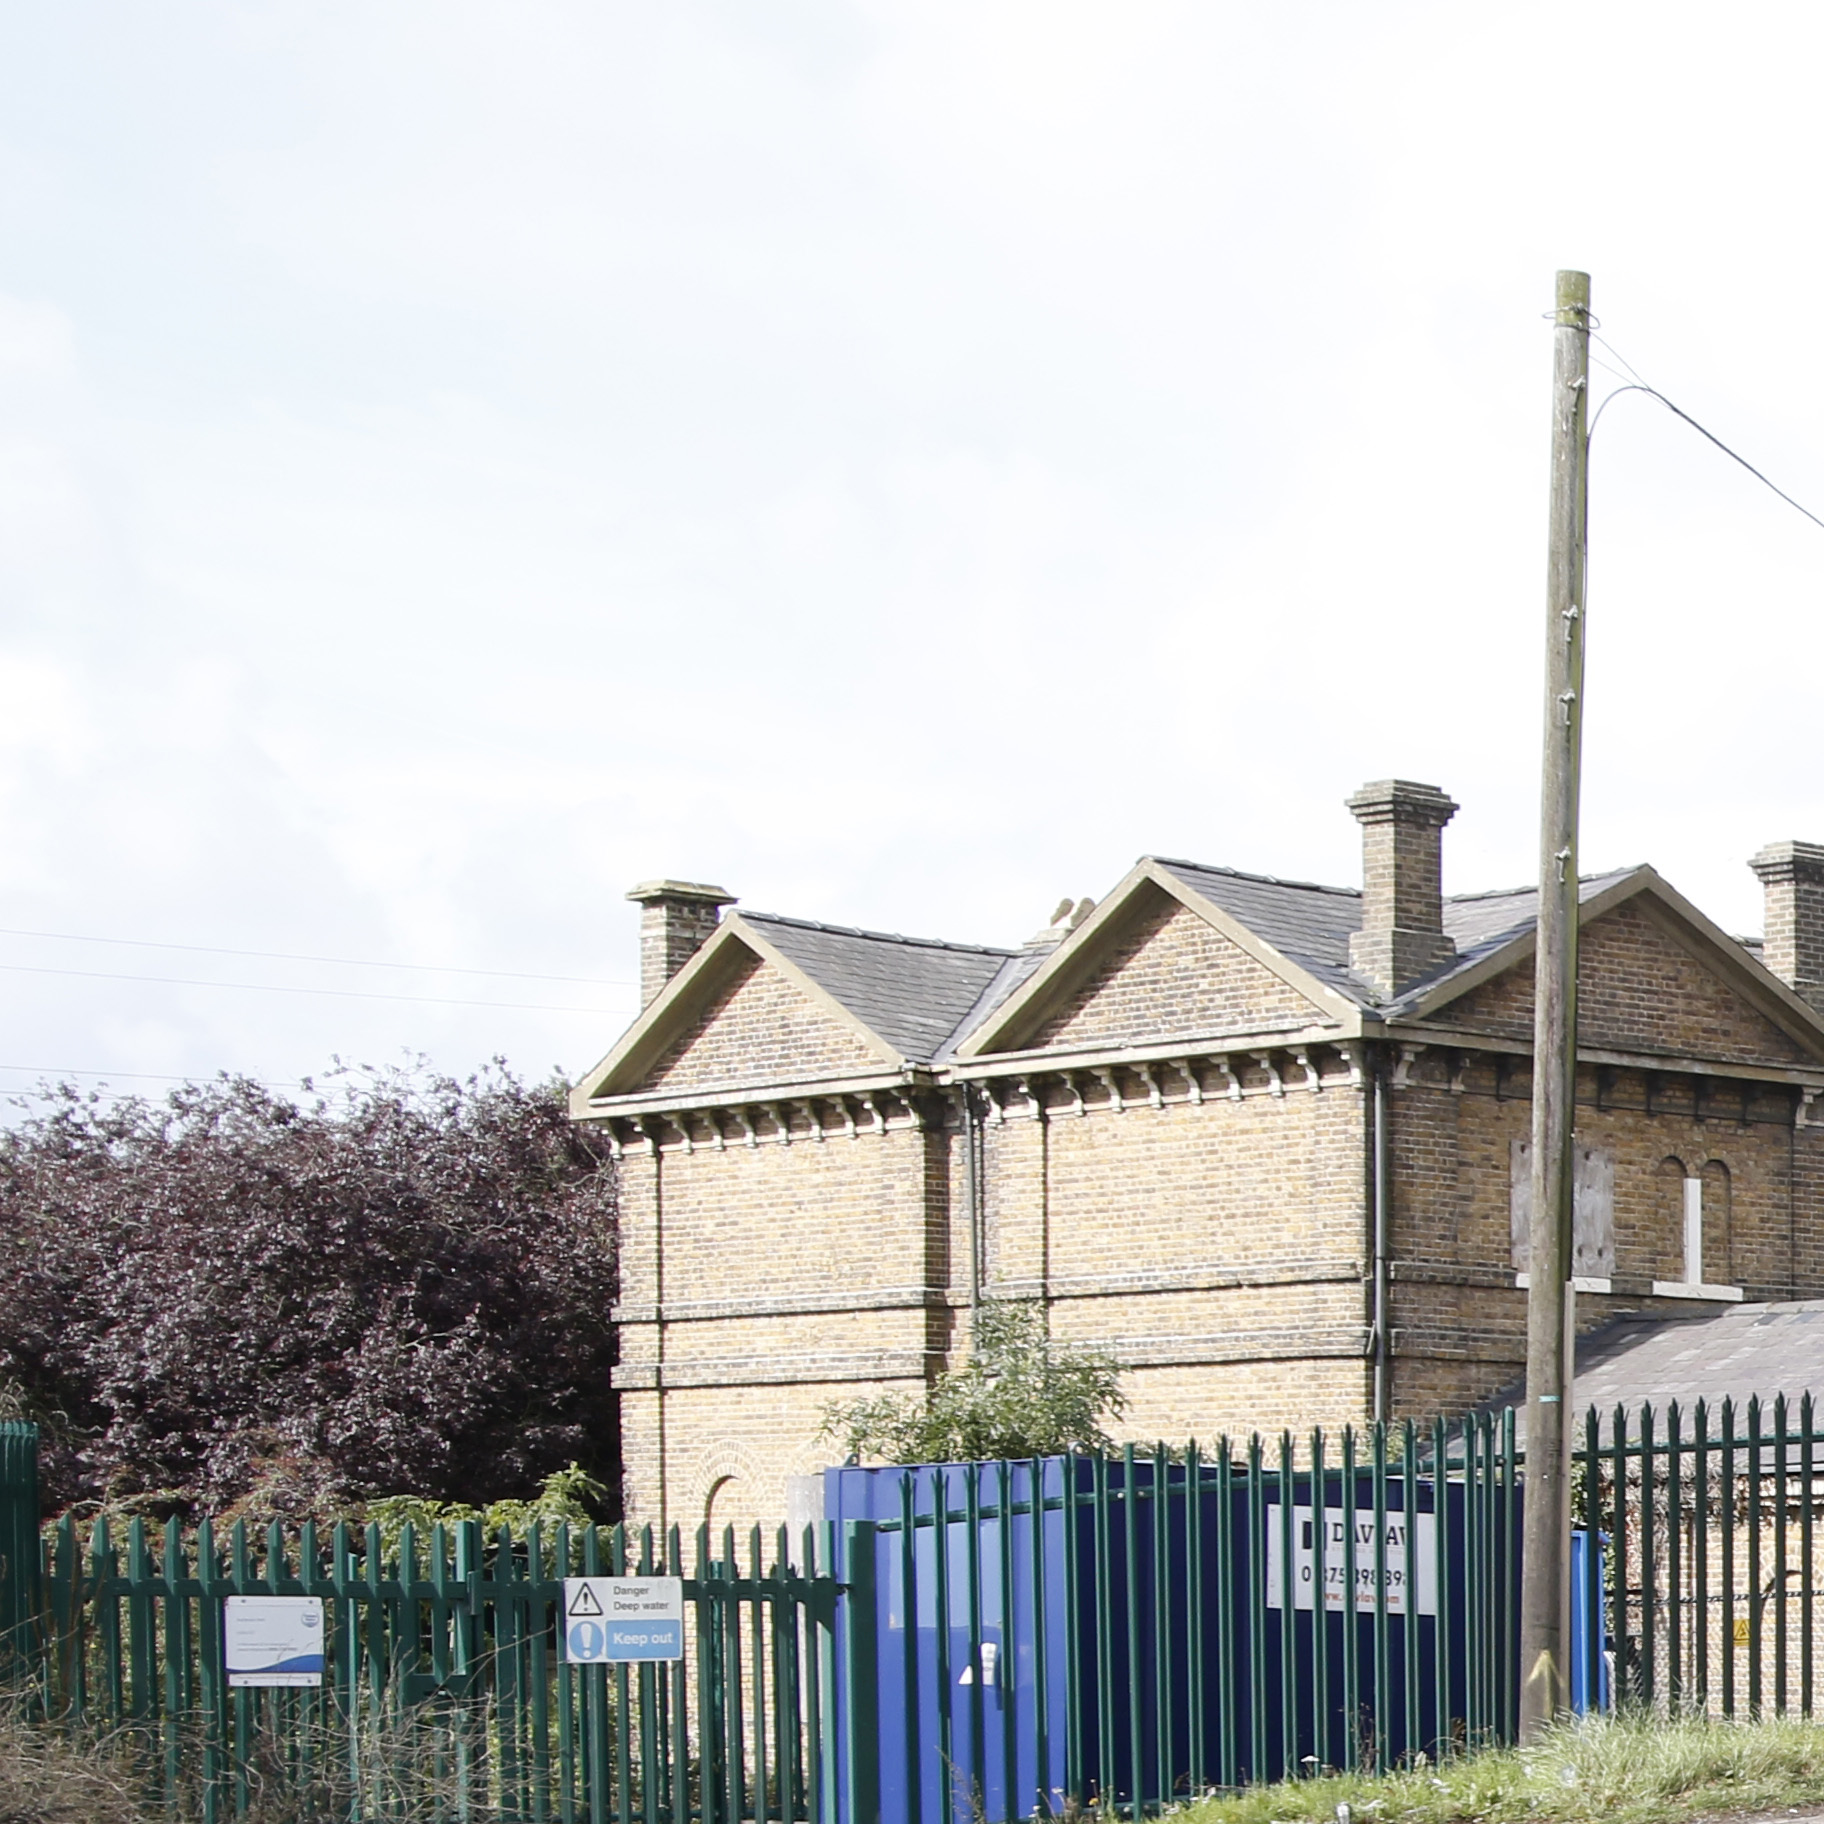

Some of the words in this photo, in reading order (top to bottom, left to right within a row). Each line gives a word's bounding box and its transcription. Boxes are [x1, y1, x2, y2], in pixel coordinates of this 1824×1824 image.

[613, 1586, 649, 1597] Danger
[613, 1602, 639, 1612] Deep
[642, 1602, 669, 1610] water
[613, 1632, 648, 1647] Keep
[652, 1633, 673, 1644] out
